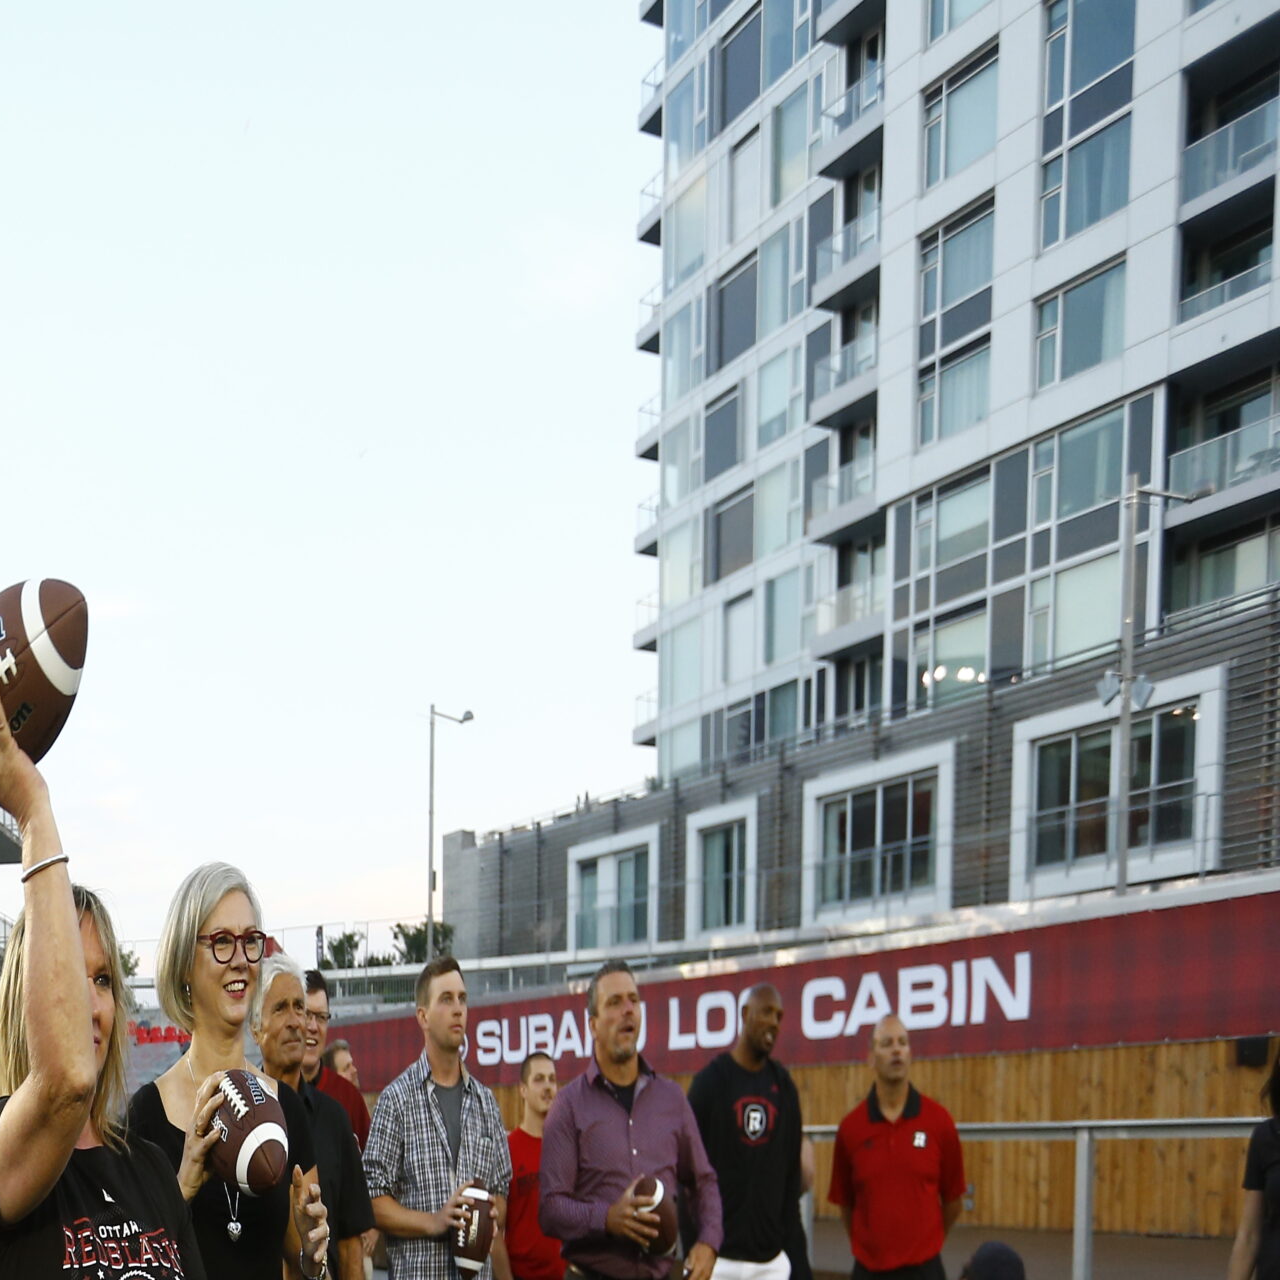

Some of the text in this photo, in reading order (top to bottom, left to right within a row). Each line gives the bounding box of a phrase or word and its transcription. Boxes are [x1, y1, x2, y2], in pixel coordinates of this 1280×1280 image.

[476, 1001, 647, 1066] SUBA
[801, 951, 1031, 1040] CABIN
[62, 1217, 184, 1277] REDBLACK
[98, 1220, 142, 1238] OTTAW
